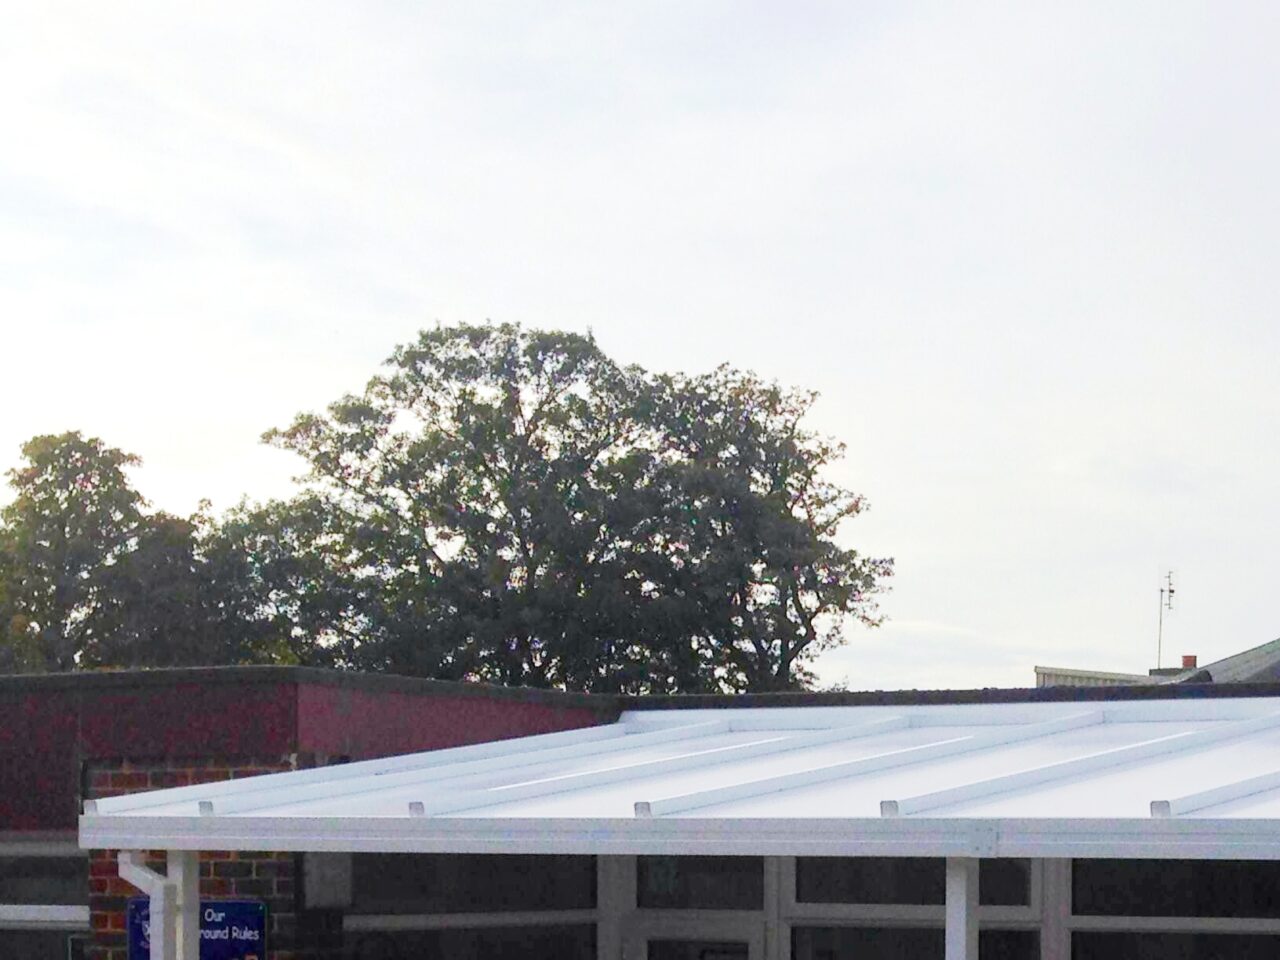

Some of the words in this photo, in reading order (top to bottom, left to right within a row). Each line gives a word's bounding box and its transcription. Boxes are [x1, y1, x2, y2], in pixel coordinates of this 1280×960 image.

[204, 908, 226, 922] Our
[199, 925, 229, 940] round
[231, 925, 260, 941] Rules
